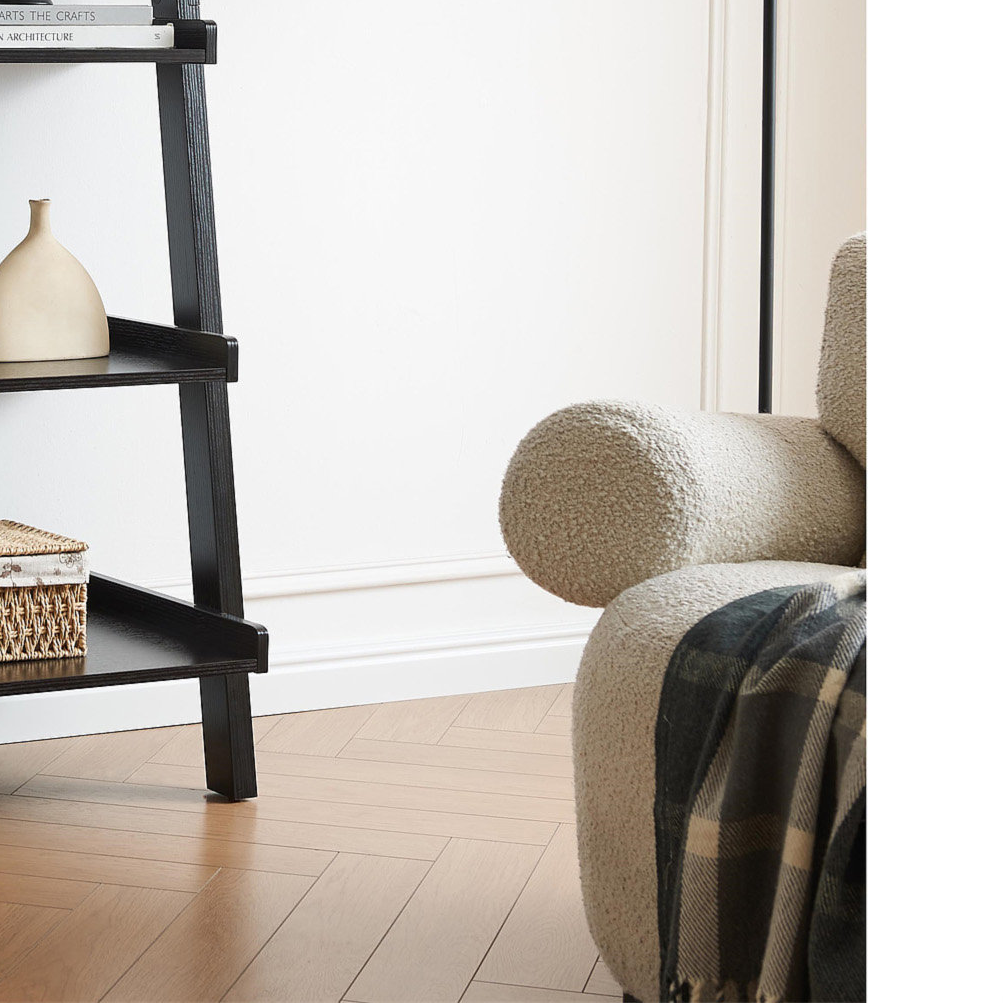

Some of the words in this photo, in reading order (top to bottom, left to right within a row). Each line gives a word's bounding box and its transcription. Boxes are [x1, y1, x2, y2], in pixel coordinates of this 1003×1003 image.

[30, 10, 51, 21] THE
[56, 11, 96, 21] CRAFTS
[6, 32, 74, 42] ARCHITECTURE
